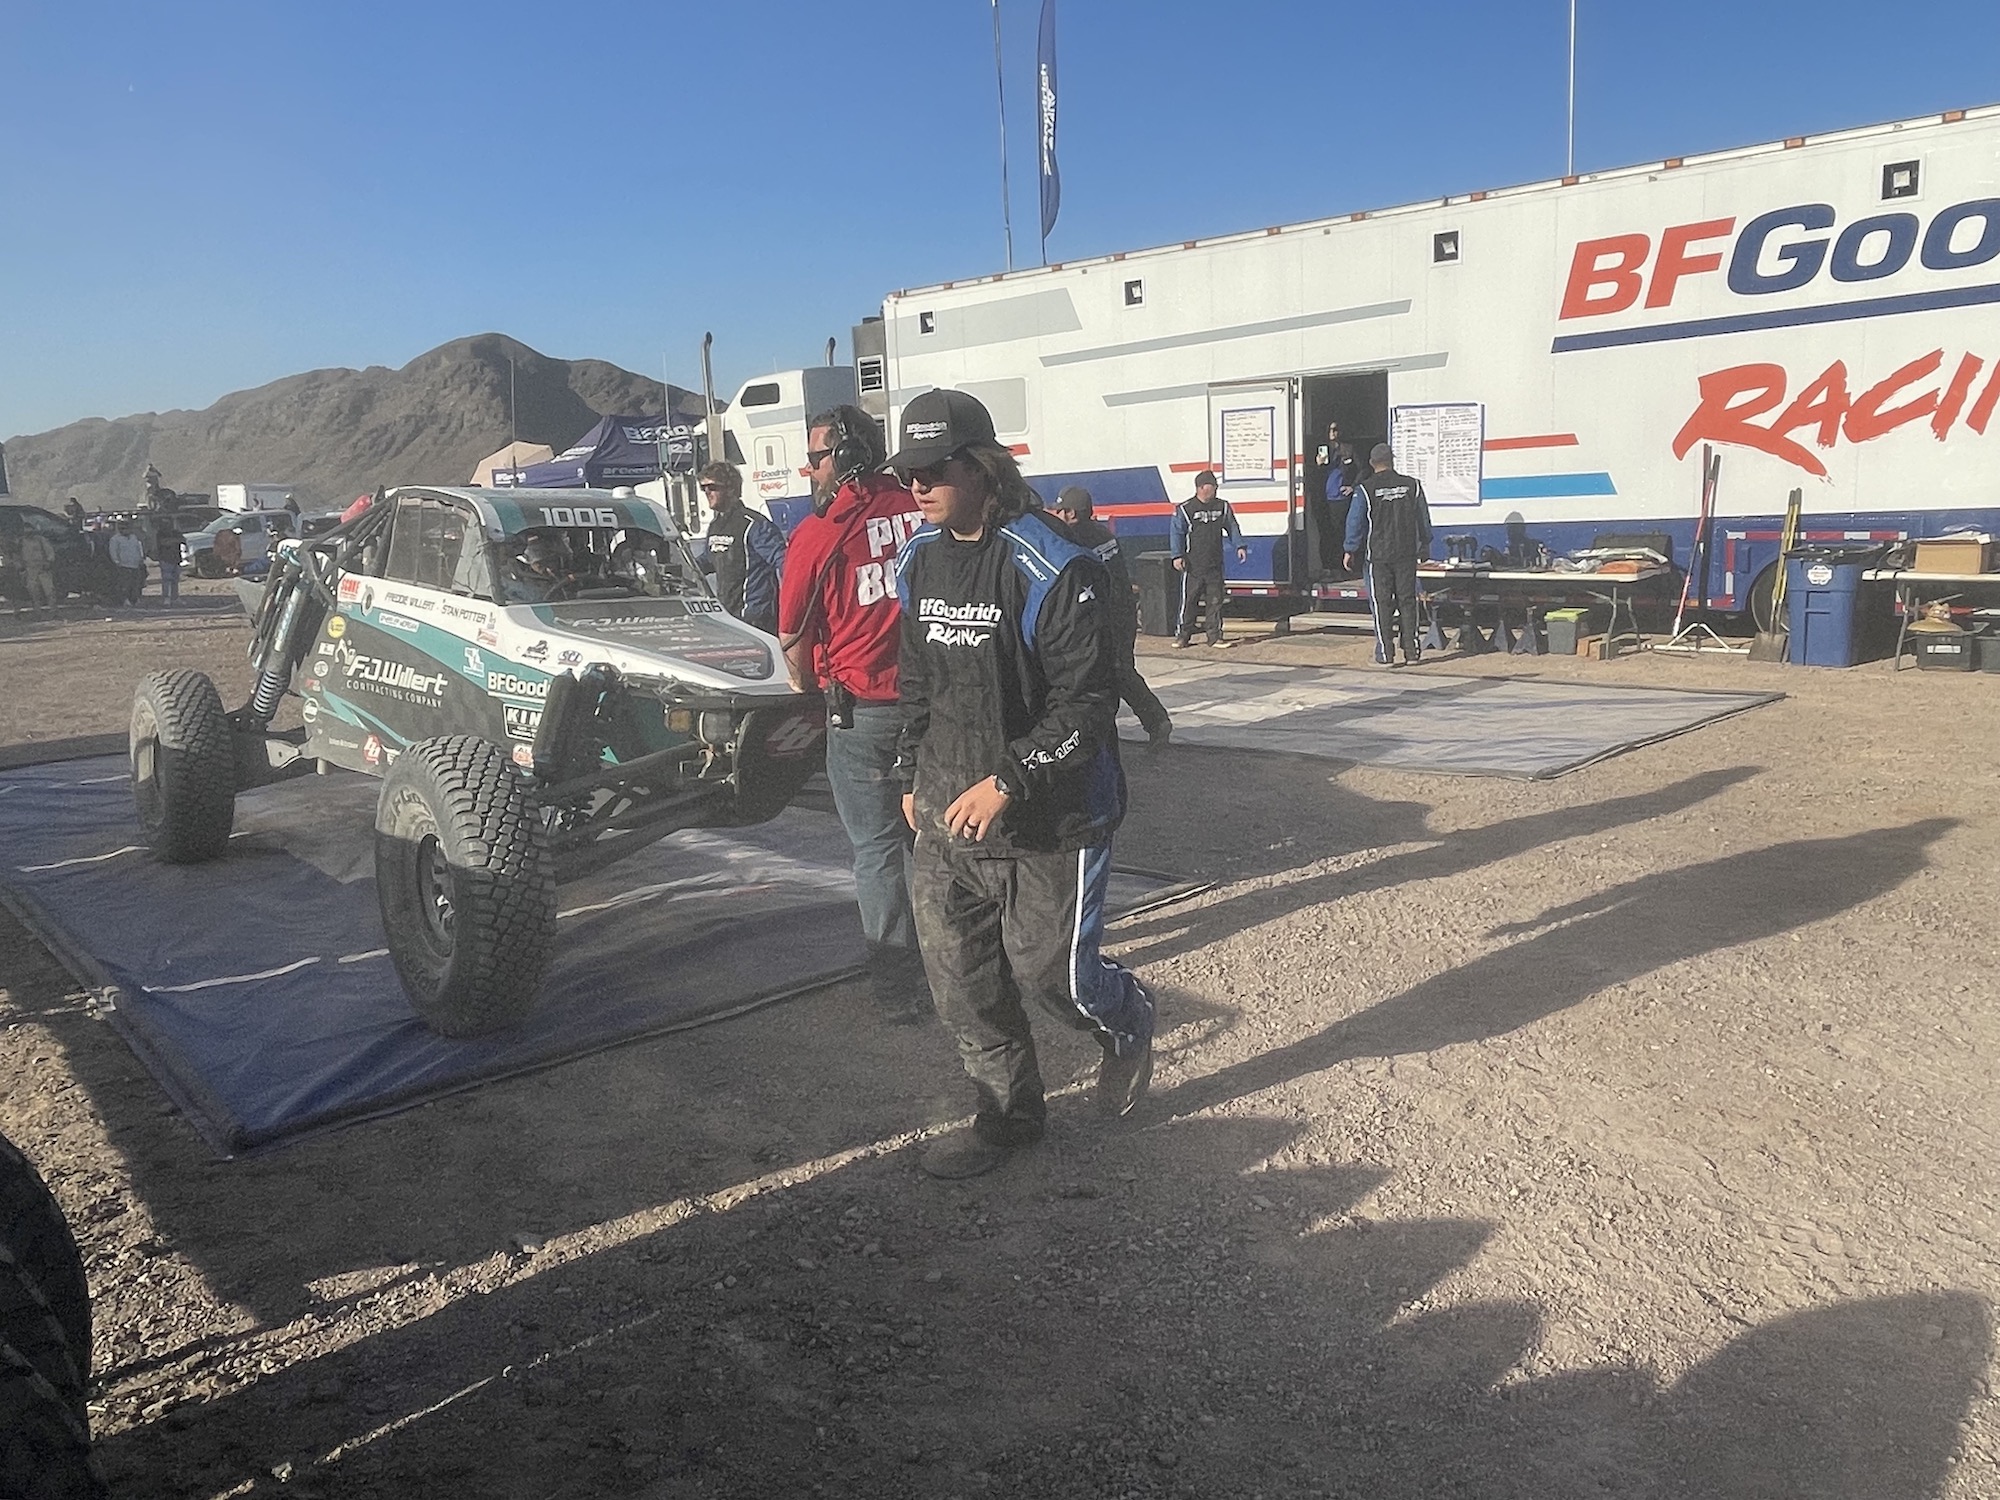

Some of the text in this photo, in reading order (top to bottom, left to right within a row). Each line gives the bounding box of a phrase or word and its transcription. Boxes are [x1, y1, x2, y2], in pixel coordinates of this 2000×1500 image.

[539, 507, 618, 528] 1006
[866, 510, 926, 558] PIT
[441, 604, 459, 618] STAN
[459, 608, 487, 625] POTTER
[686, 600, 723, 614] 1006
[346, 679, 442, 708] CONTRACTING COMPANY
